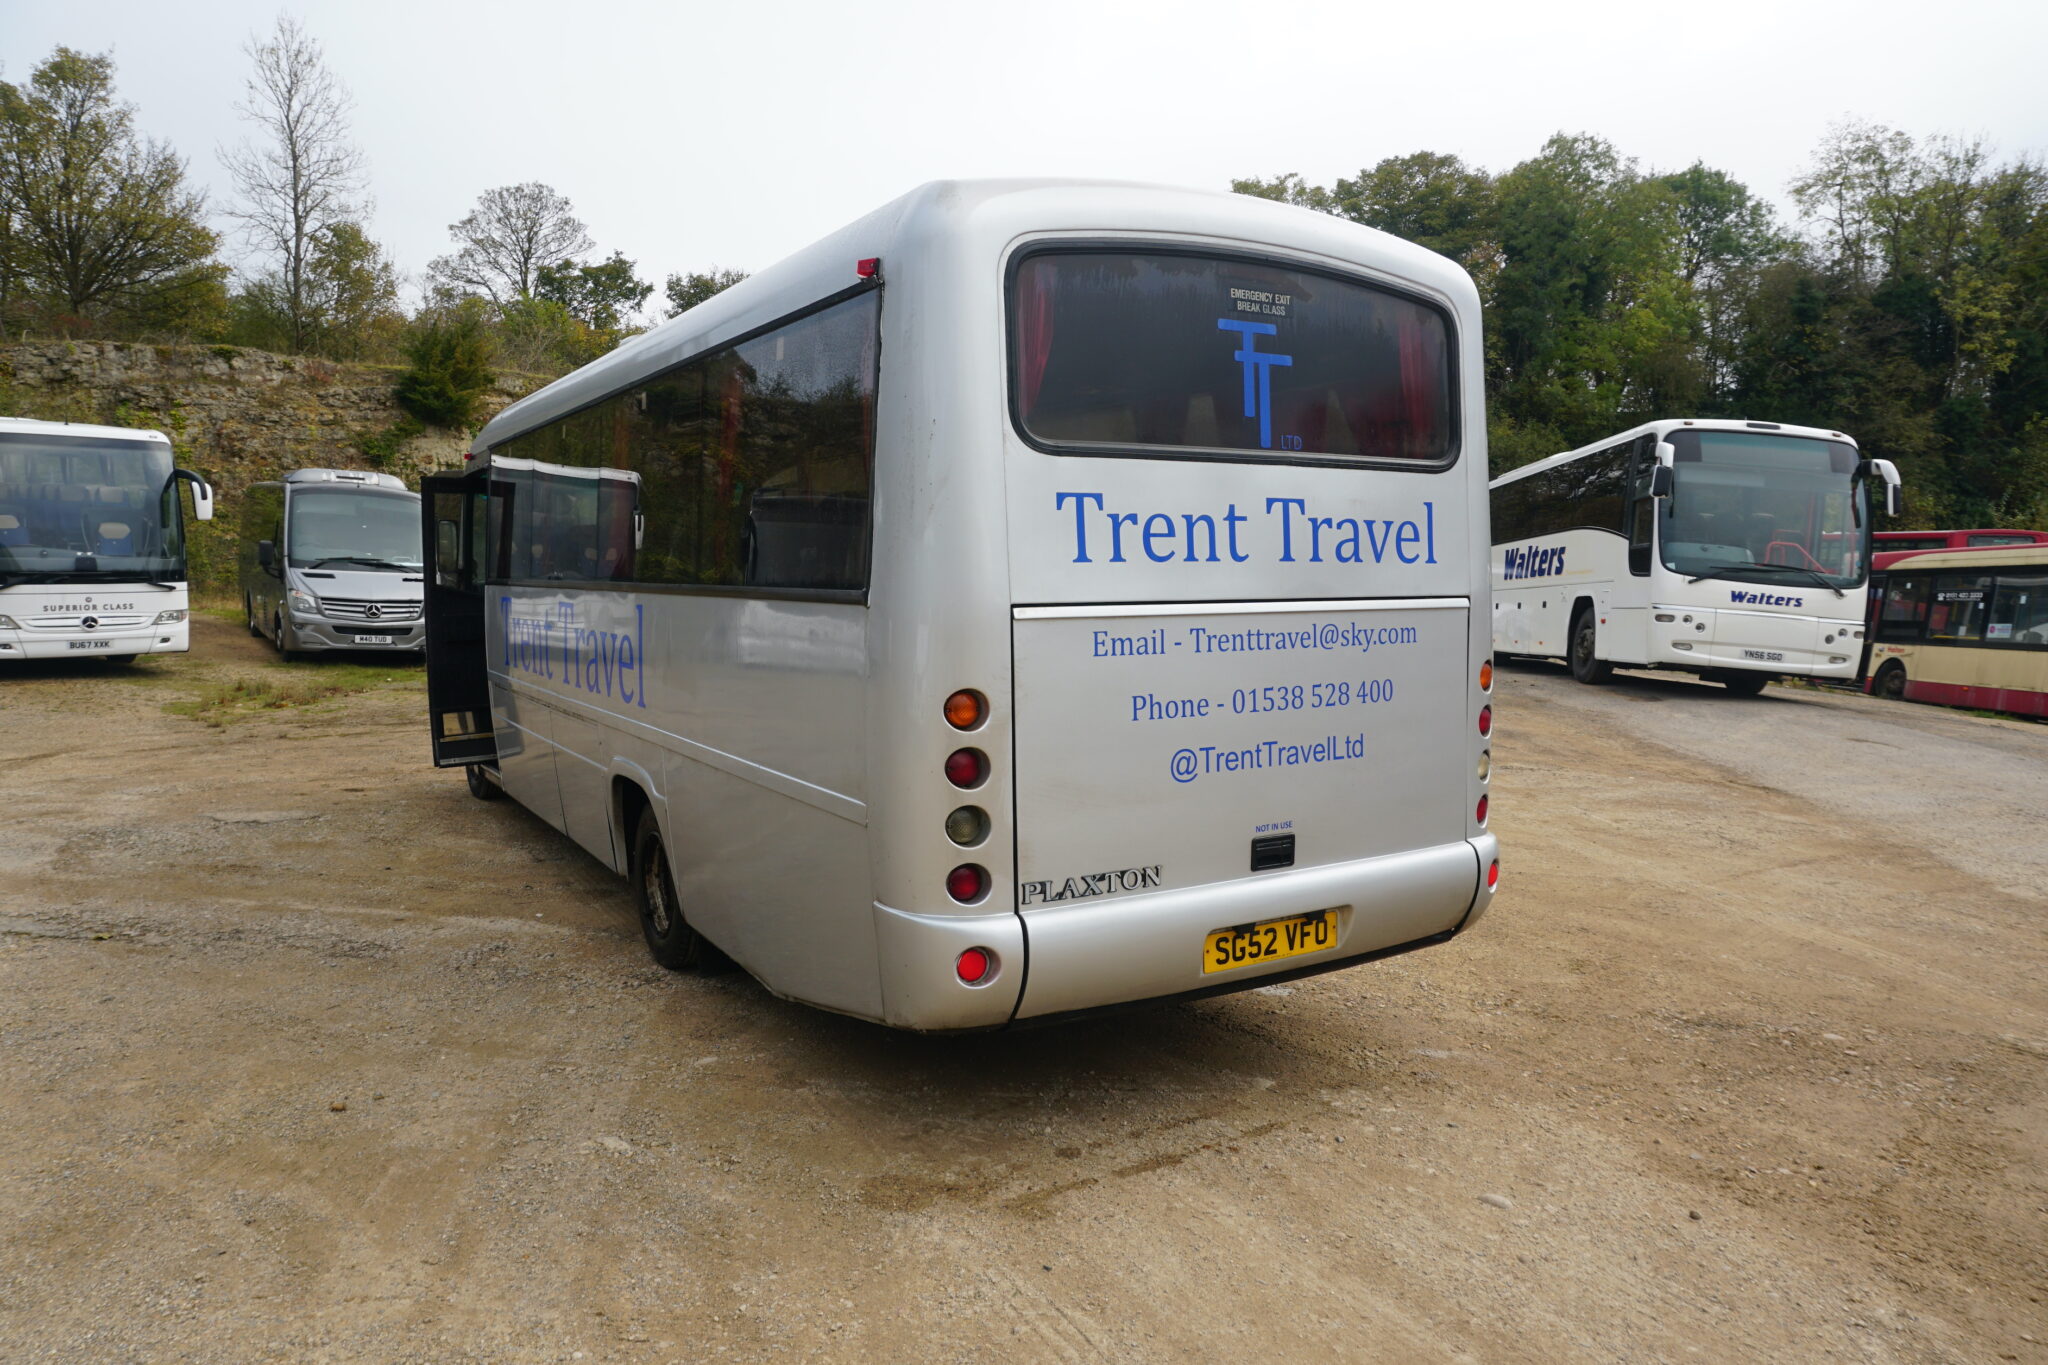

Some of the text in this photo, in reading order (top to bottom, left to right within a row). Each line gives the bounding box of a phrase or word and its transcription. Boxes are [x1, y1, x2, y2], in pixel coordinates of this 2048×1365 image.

[1230, 288, 1291, 305] EMERGENCY EXIT
[1237, 300, 1286, 316] BREAK GLASS
[1280, 435, 1302, 450] LTD
[1056, 491, 1438, 565] Trent Travel
[1504, 545, 1566, 580] Walters
[43, 603, 135, 612] SUPERIOR CLASS
[1731, 590, 1804, 608] Walters
[69, 641, 92, 649] BU67
[501, 596, 646, 708] Trent Travel
[1093, 628, 1166, 657] Email
[1189, 622, 1417, 653] Trenttravel@sky.com
[1744, 650, 1765, 660] YN56
[1131, 693, 1210, 721] Phone
[1232, 685, 1304, 714] 01538
[1311, 681, 1350, 708] 528
[1356, 678, 1393, 704] 400
[1170, 733, 1364, 783] @TrentTravelLtd
[1255, 820, 1293, 833] NOT IN USE
[1021, 864, 1162, 905] PLAXTON
[1215, 927, 1278, 966] SG52
